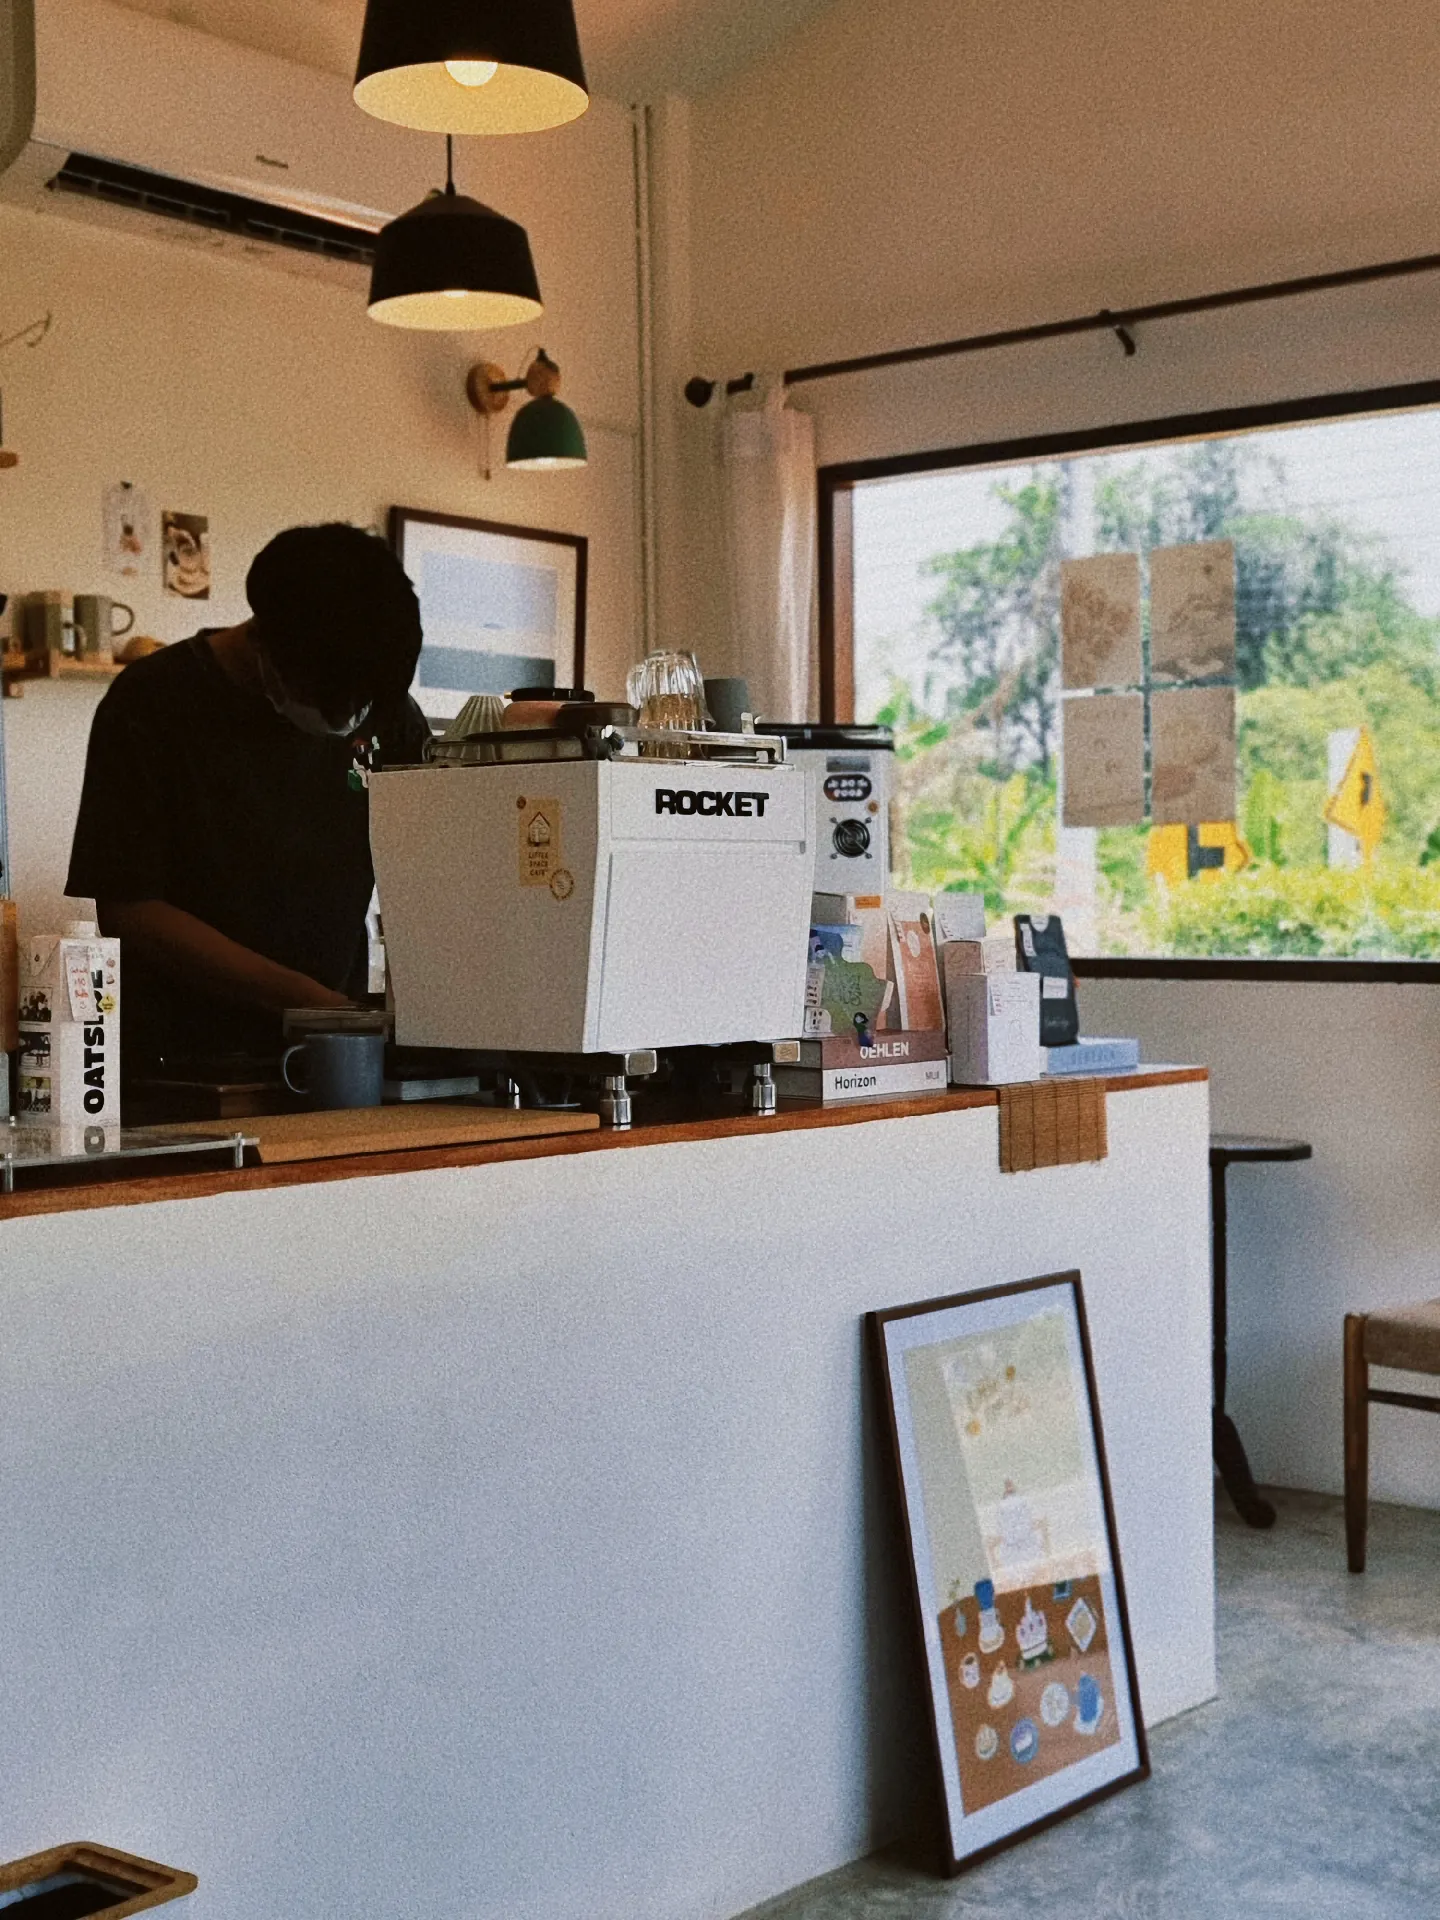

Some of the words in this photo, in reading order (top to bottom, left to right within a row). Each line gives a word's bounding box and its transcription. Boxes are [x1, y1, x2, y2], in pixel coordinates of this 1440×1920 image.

[655, 788, 770, 817] ROCKET
[859, 1042, 910, 1060] OEHLEN
[834, 1074, 877, 1090] Horizon
